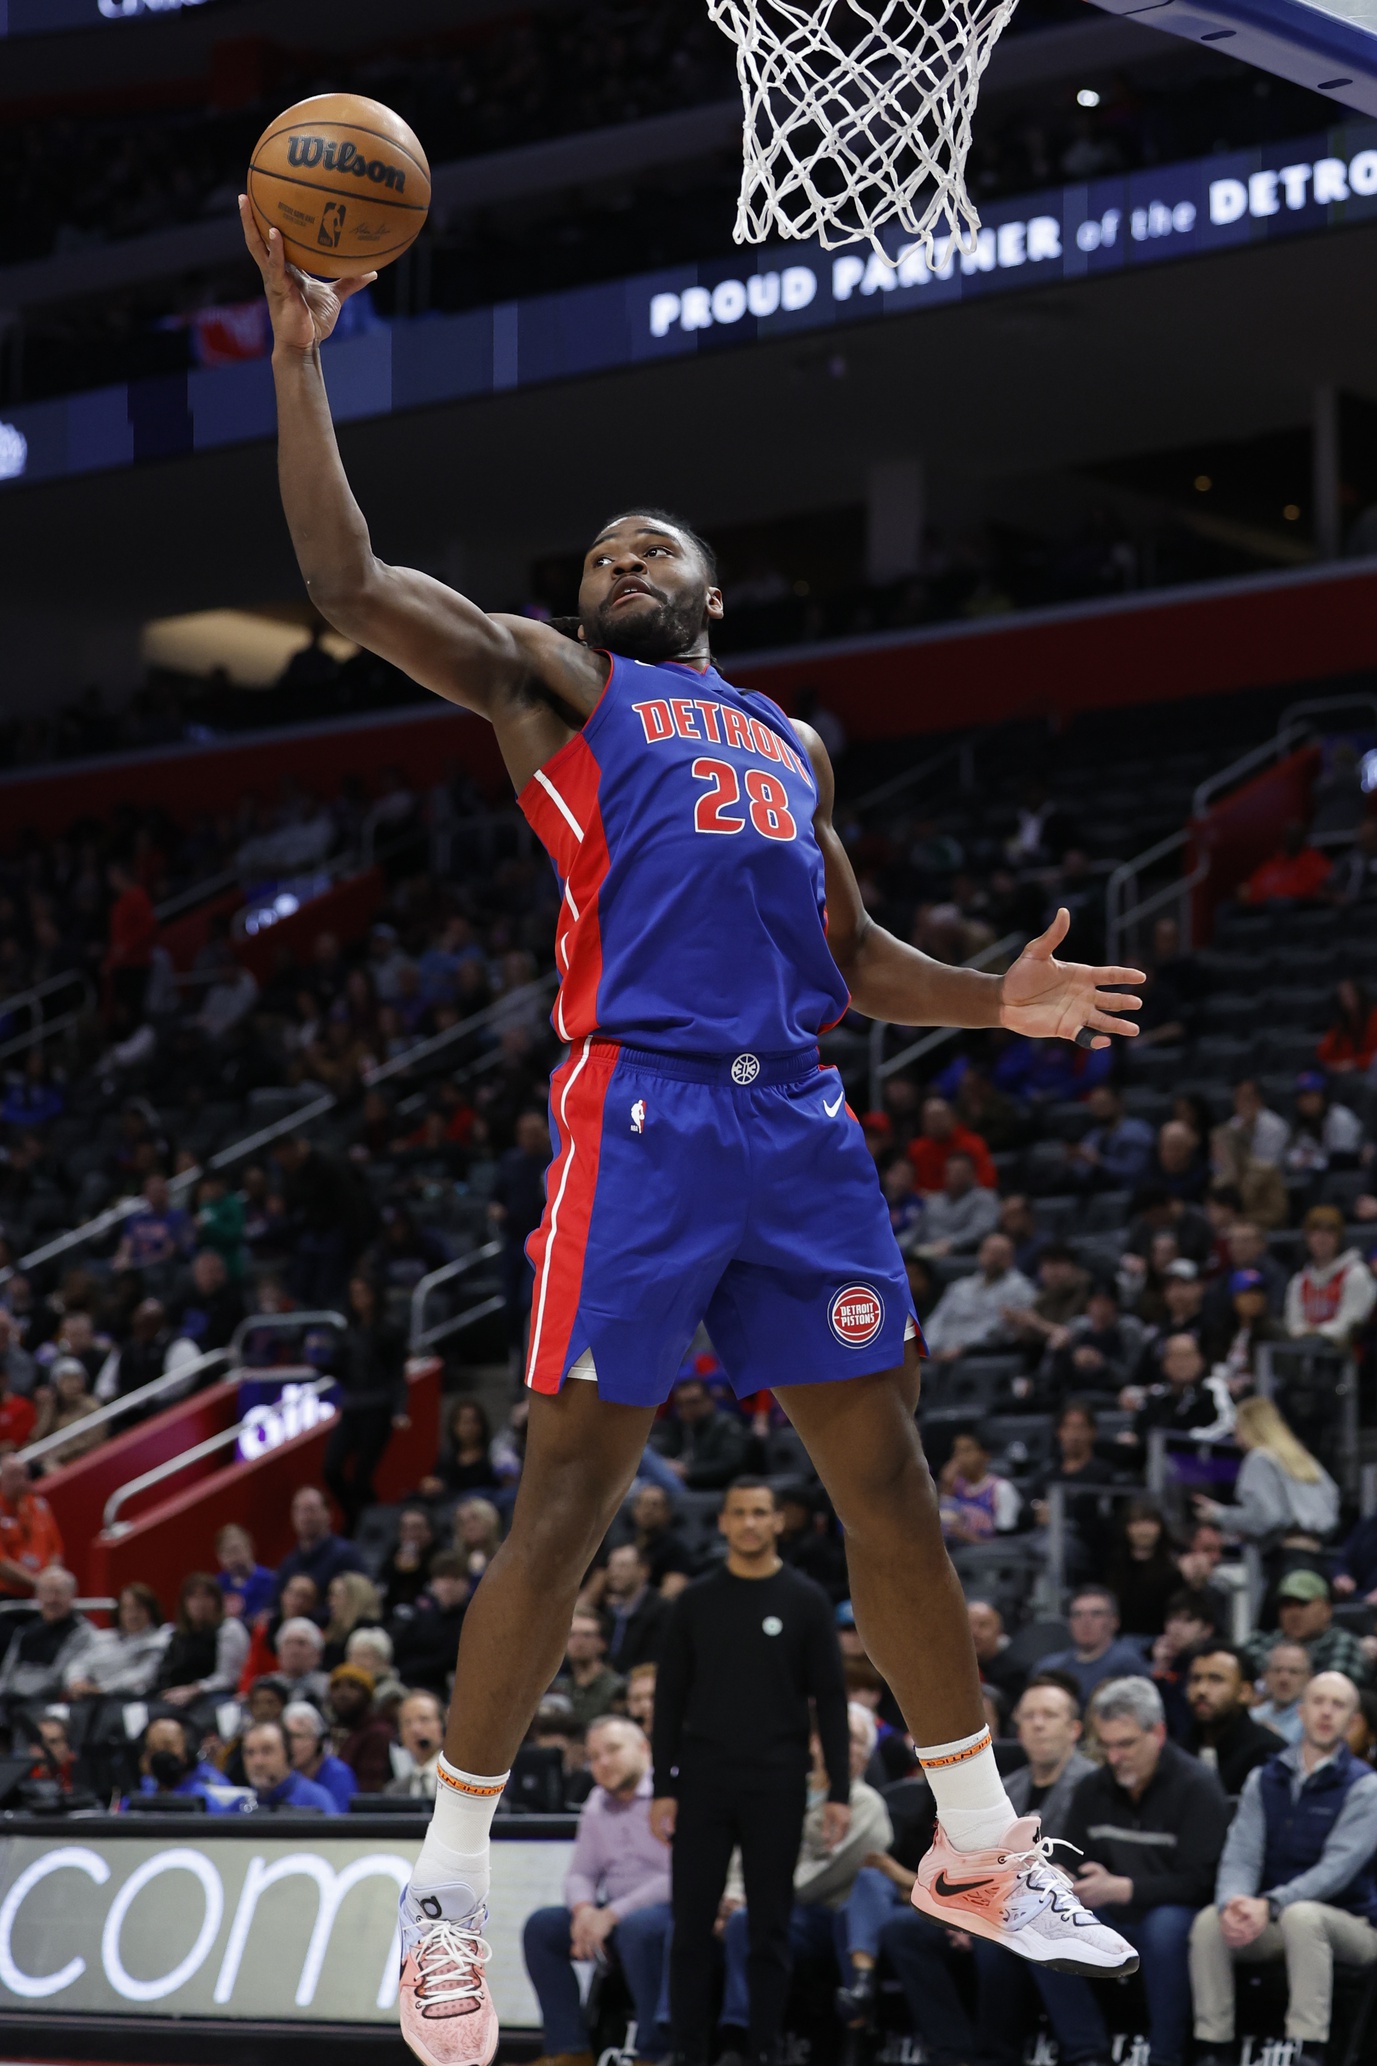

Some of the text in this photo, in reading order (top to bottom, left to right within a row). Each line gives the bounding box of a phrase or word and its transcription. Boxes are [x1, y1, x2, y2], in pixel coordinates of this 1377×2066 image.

[287, 134, 406, 194] Wilson
[650, 265, 817, 337] PROUD
[1076, 208, 1121, 252] of
[1131, 200, 1197, 242] the
[1209, 149, 1377, 226] DETRO
[692, 757, 797, 841] 28
[840, 1303, 873, 1316] DETROIT
[841, 1314, 874, 1327] PISTONS
[0, 1847, 413, 2009] com
